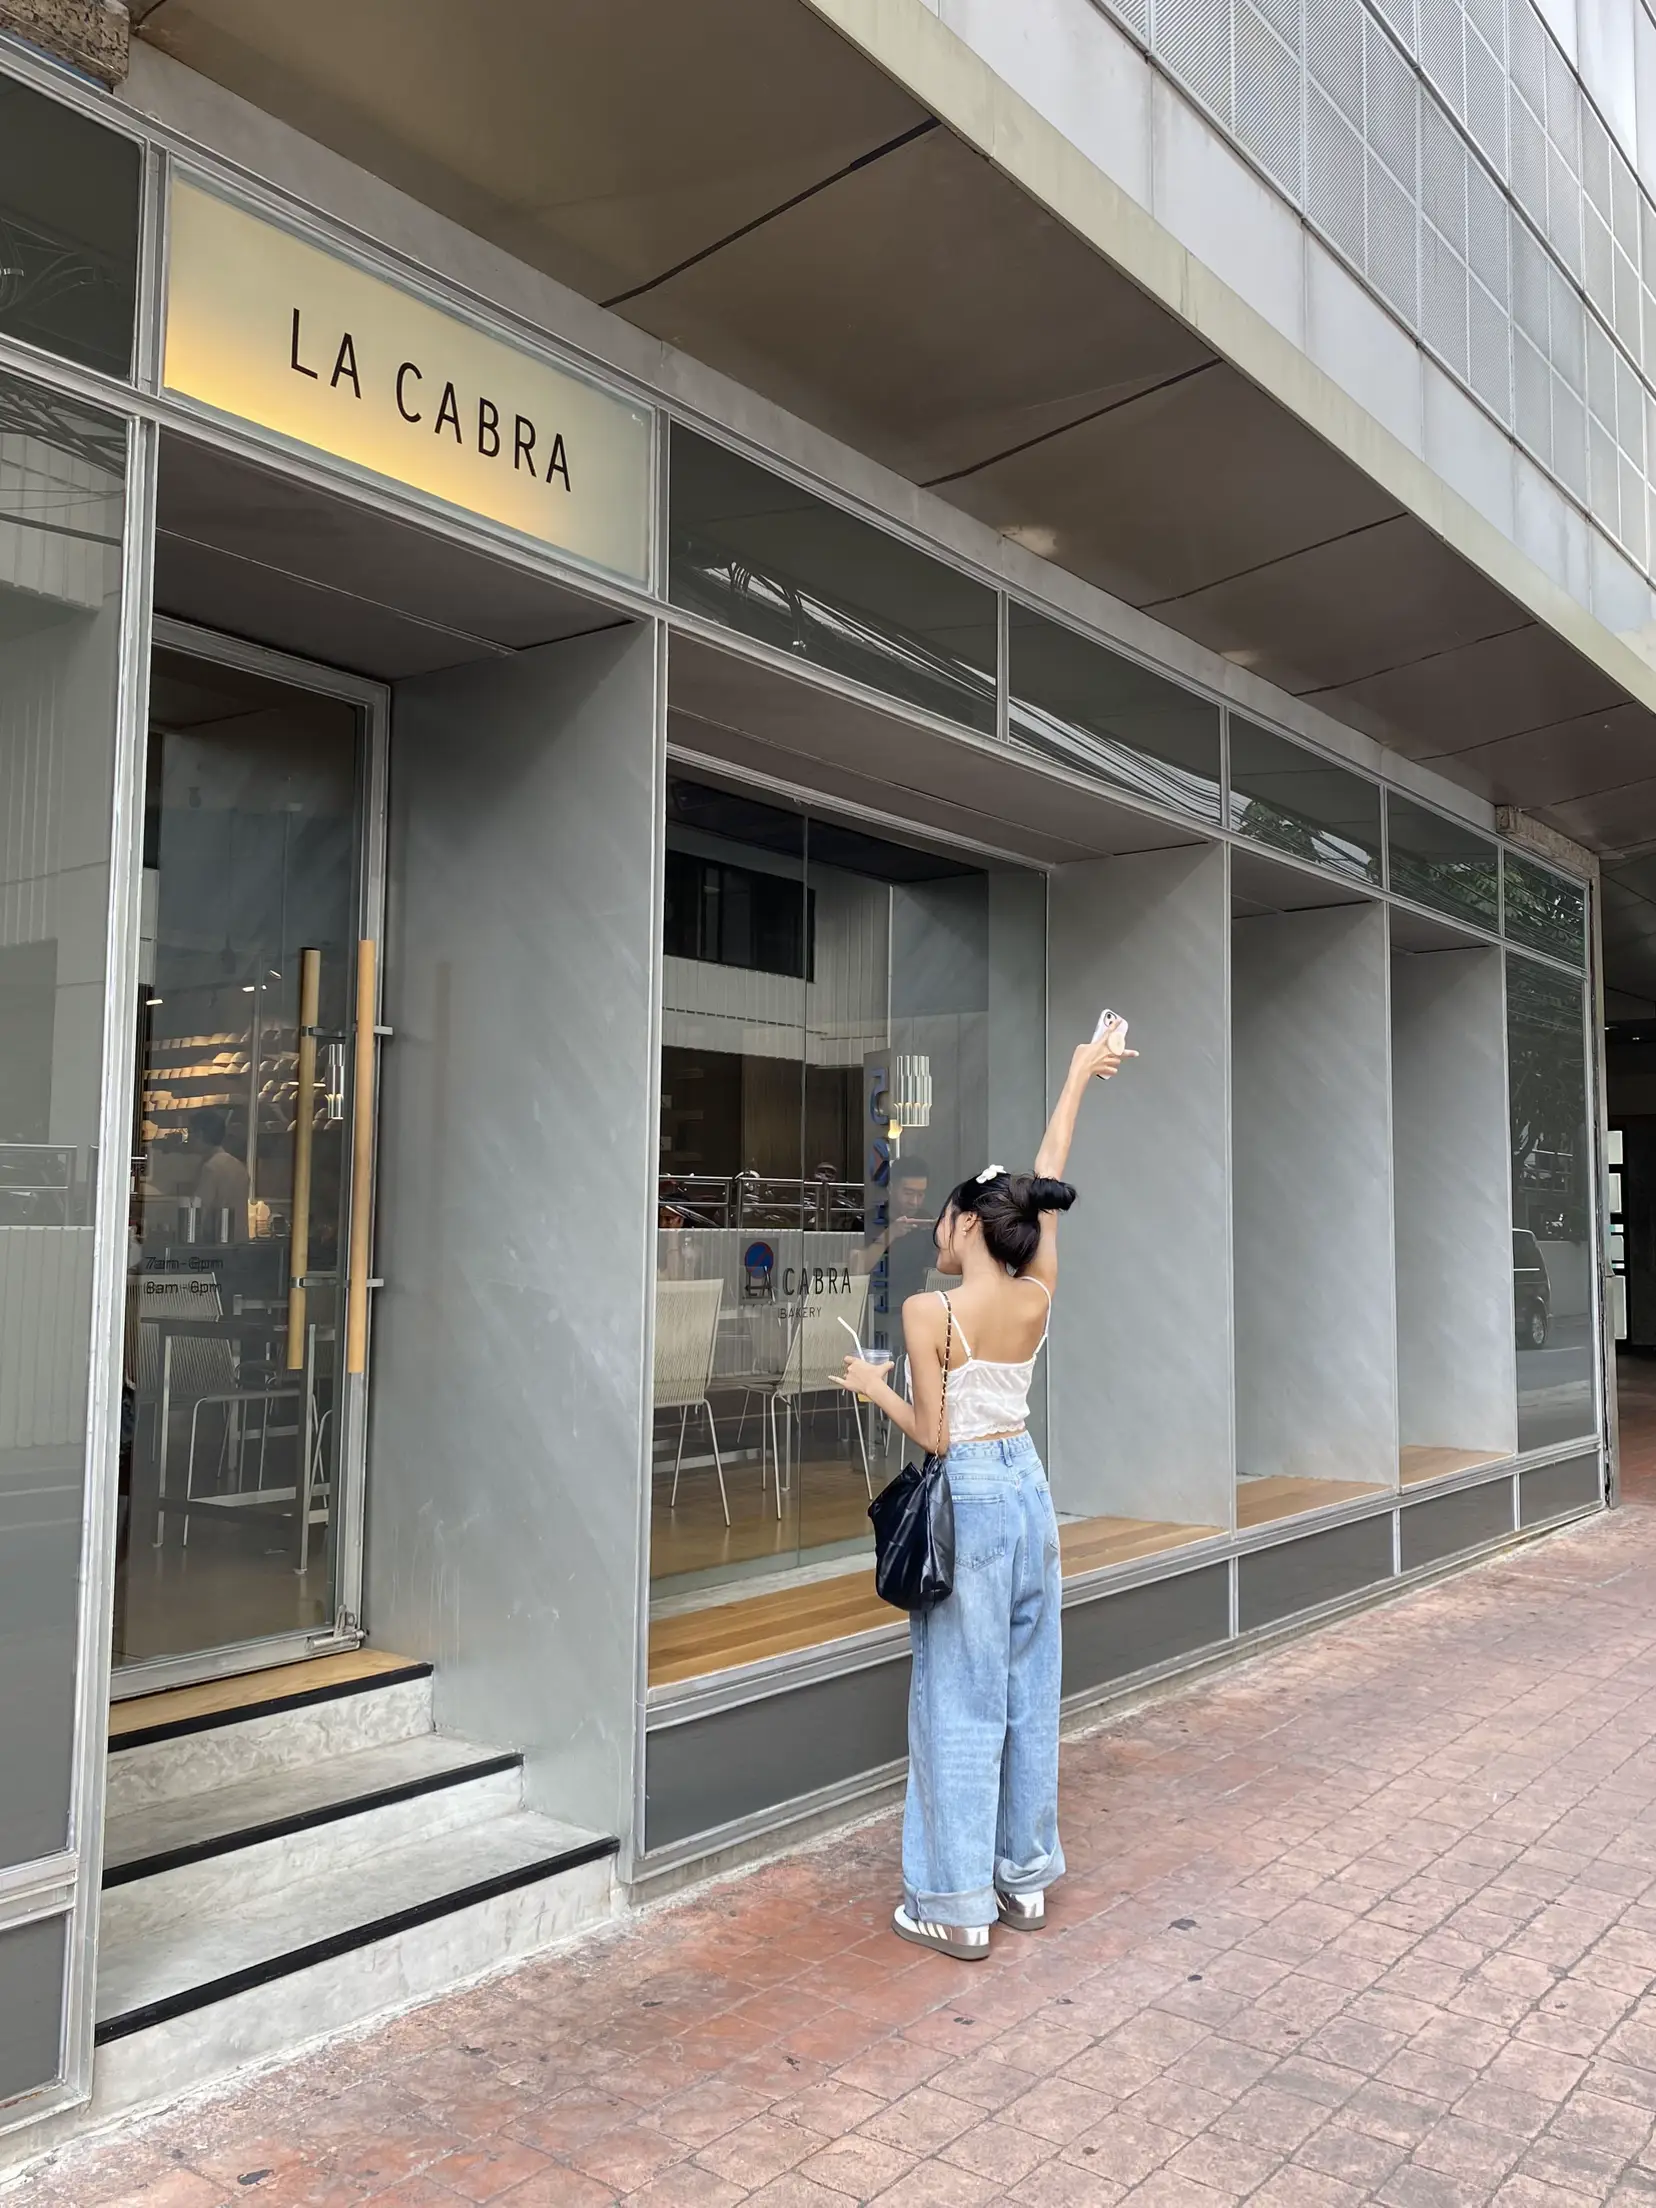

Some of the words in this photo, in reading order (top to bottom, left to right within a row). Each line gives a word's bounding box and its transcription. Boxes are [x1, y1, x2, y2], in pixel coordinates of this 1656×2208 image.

[291, 307, 361, 399] LA
[396, 362, 571, 492] CABRA
[746, 1266, 774, 1297] LA
[782, 1267, 852, 1296] CABRA
[778, 1306, 822, 1319] BAKERY
